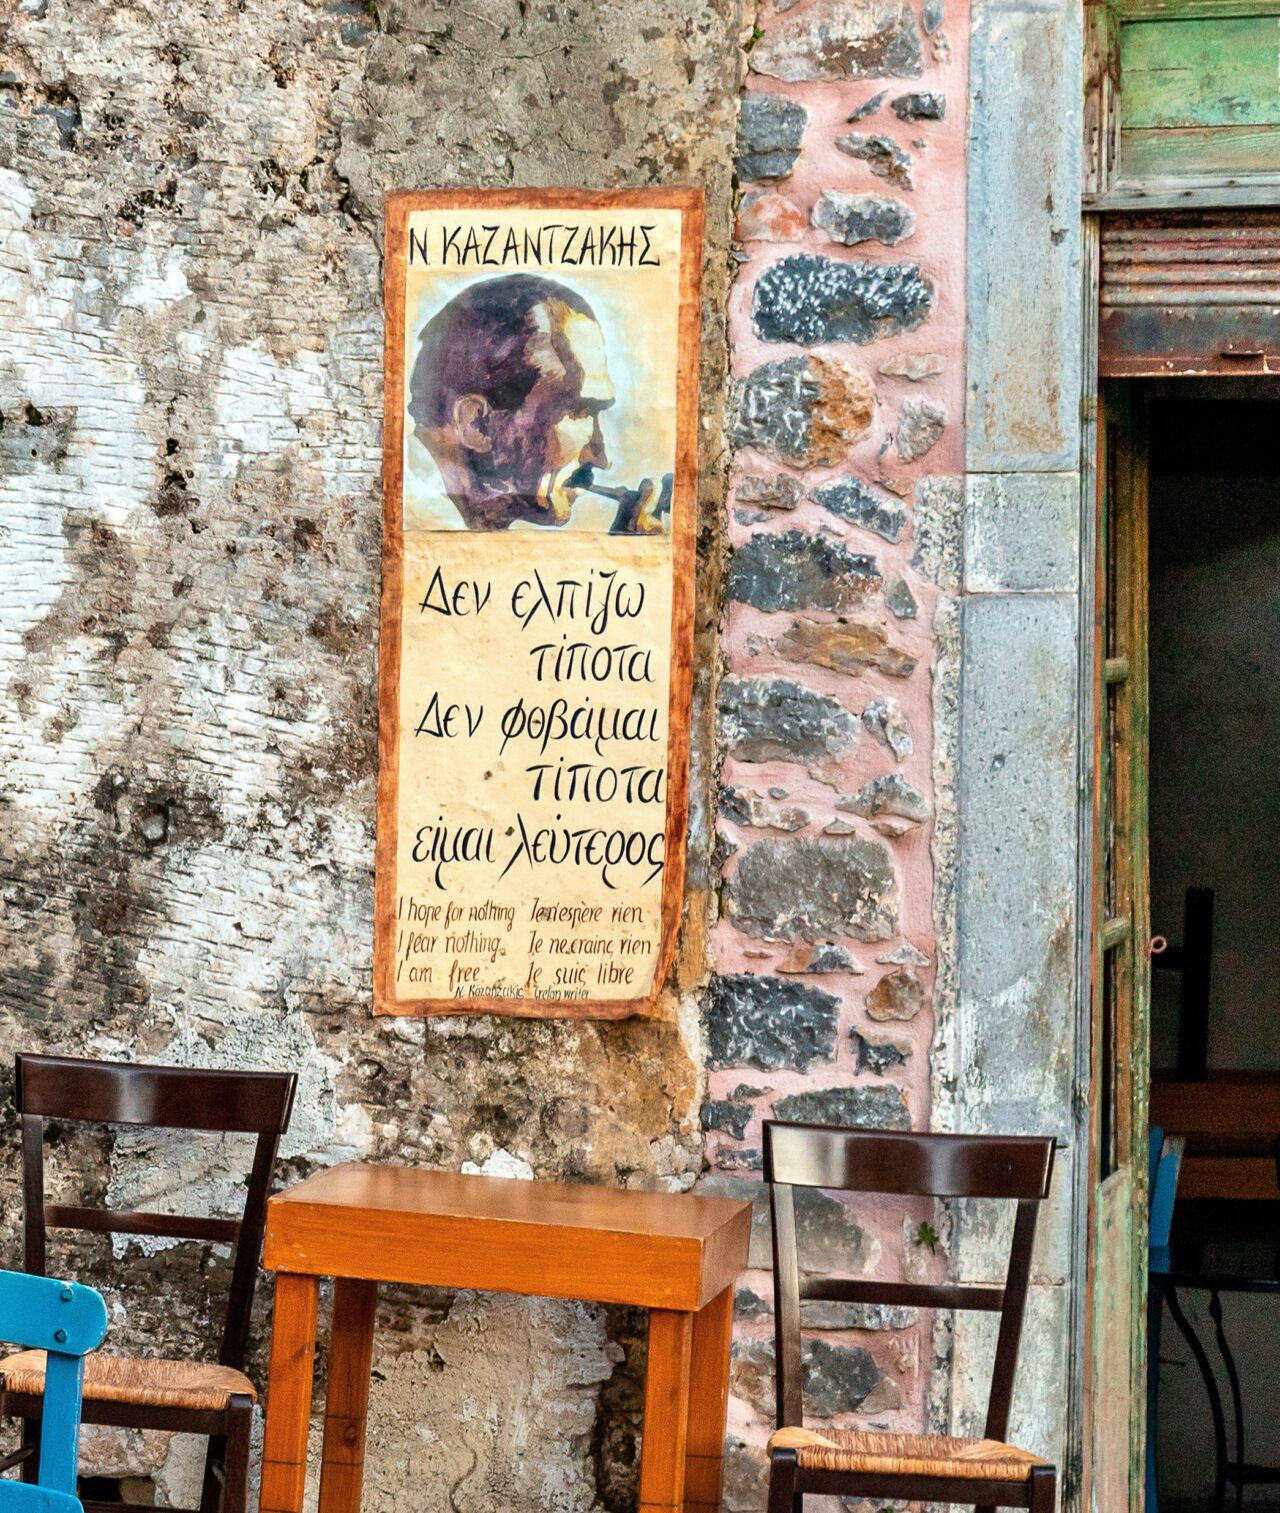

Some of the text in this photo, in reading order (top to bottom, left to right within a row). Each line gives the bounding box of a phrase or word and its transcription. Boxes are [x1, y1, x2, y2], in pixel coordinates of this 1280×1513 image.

[442, 224, 661, 267] ΚΑΖΑΝΤΖΑΚΗΣ
[418, 565, 646, 635] Δεν ελπίζω
[529, 633, 656, 683] τίποτα
[414, 691, 661, 757] Δεν φοβάμαι
[525, 756, 666, 804] τίποτα
[412, 813, 666, 891] είμαι λεύτερος
[398, 895, 516, 932] I hope for nothing
[611, 901, 644, 923] rien
[397, 929, 502, 964] I fear nothing
[528, 930, 651, 957] Je ne crains rien
[397, 959, 481, 993] I am free
[526, 960, 635, 987] Je suis libre
[564, 986, 590, 1000] writer
